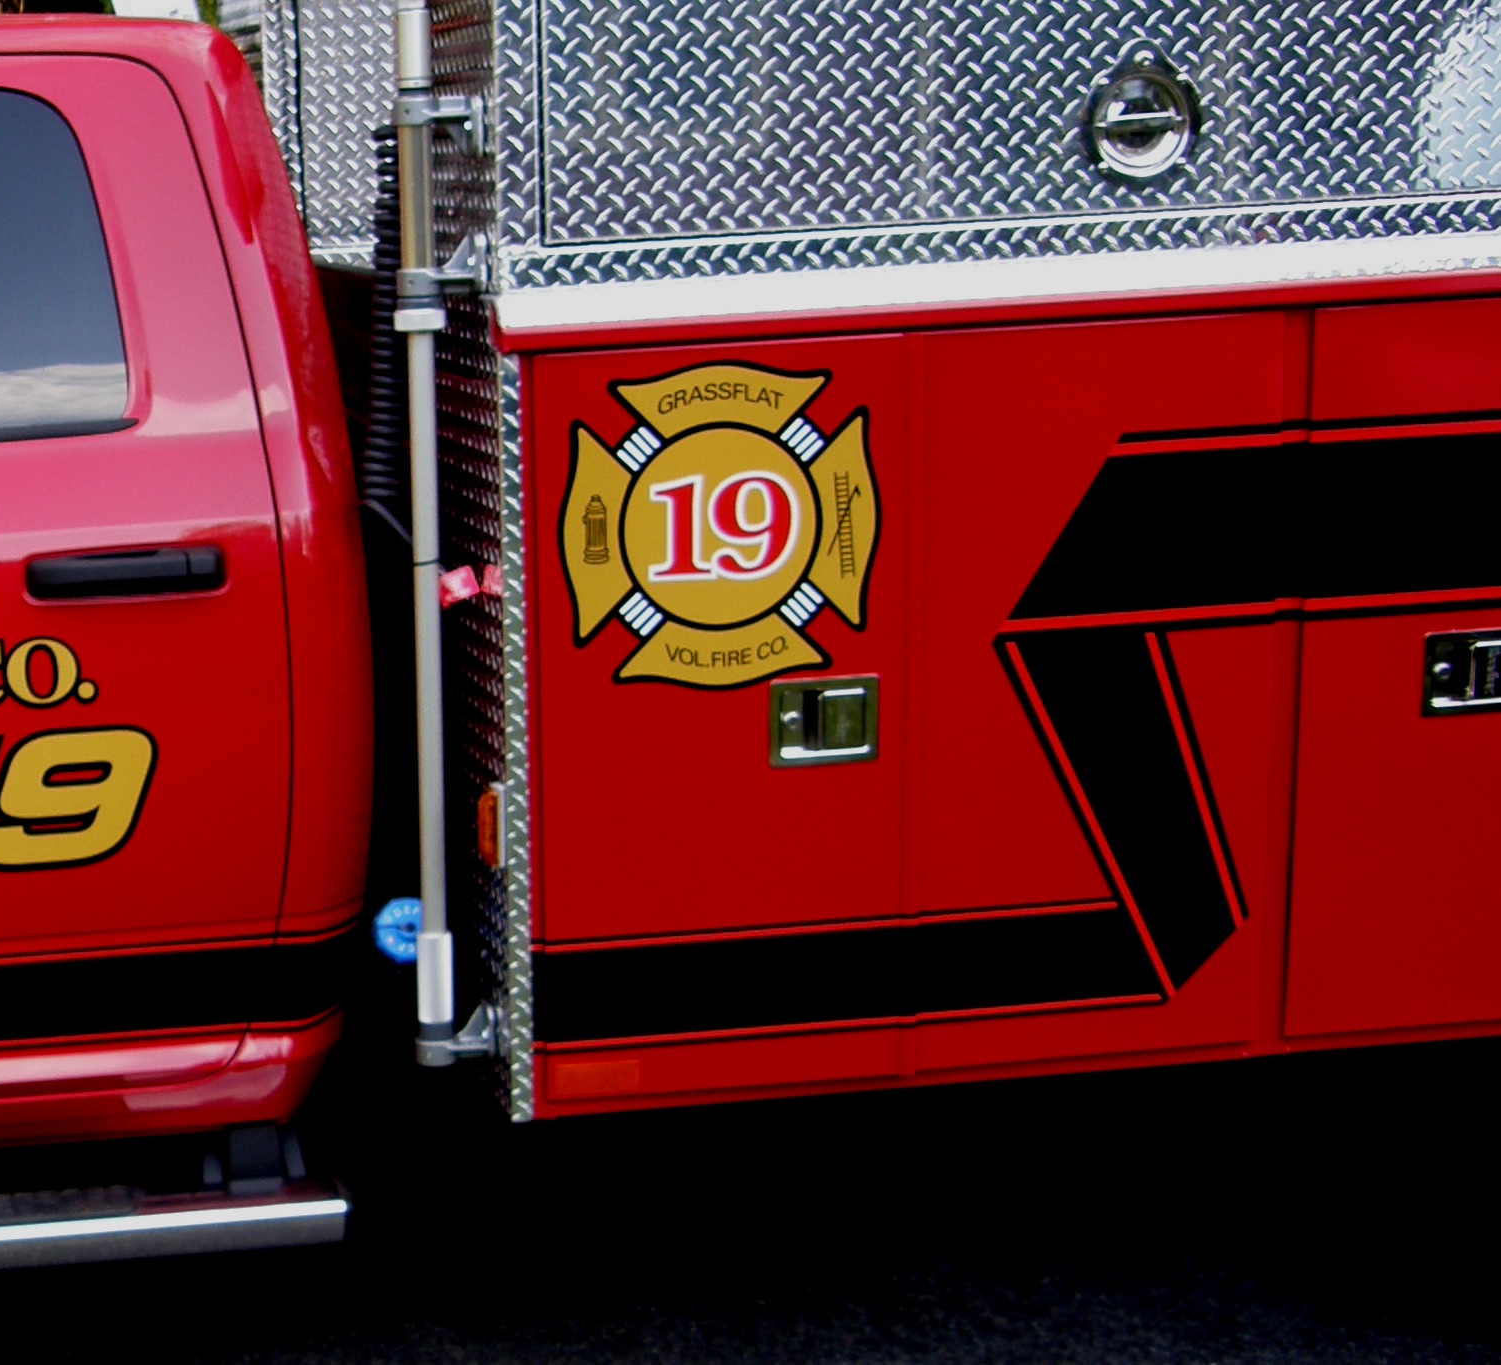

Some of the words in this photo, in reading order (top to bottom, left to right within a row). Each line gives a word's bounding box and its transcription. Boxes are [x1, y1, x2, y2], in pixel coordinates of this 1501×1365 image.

[657, 382, 784, 414] GRASSFLAT
[648, 470, 800, 583] 19
[756, 636, 789, 660] CO.
